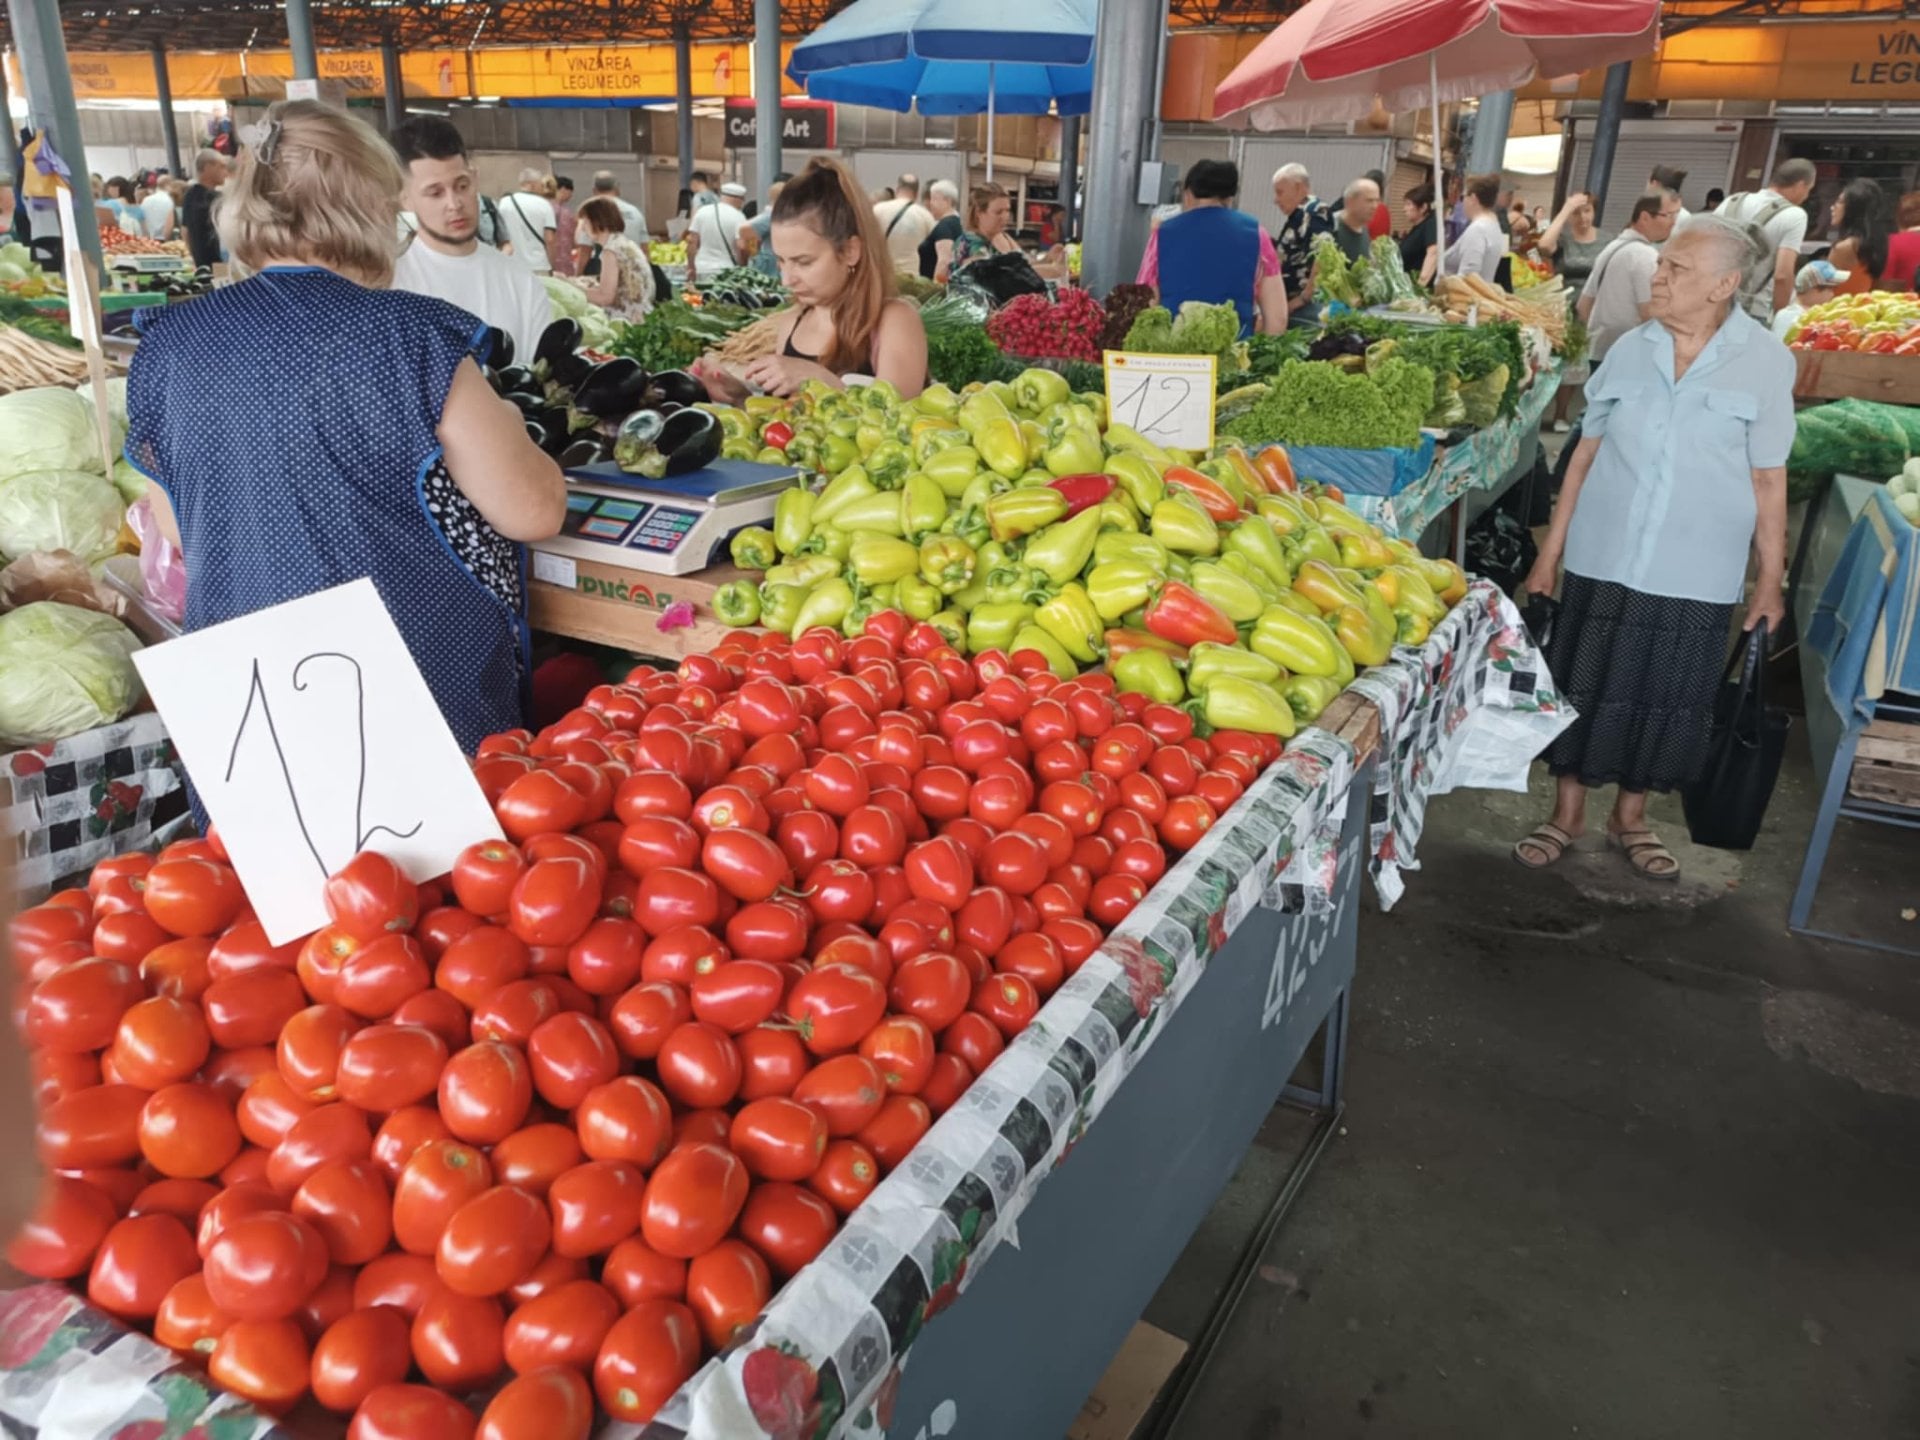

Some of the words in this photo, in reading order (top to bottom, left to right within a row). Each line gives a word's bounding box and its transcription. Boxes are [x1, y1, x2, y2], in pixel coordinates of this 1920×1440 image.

[561, 74, 641, 90] LEGUMELOR
[782, 118, 810, 137] Art
[1116, 373, 1191, 435] 12
[224, 651, 424, 879] 12
